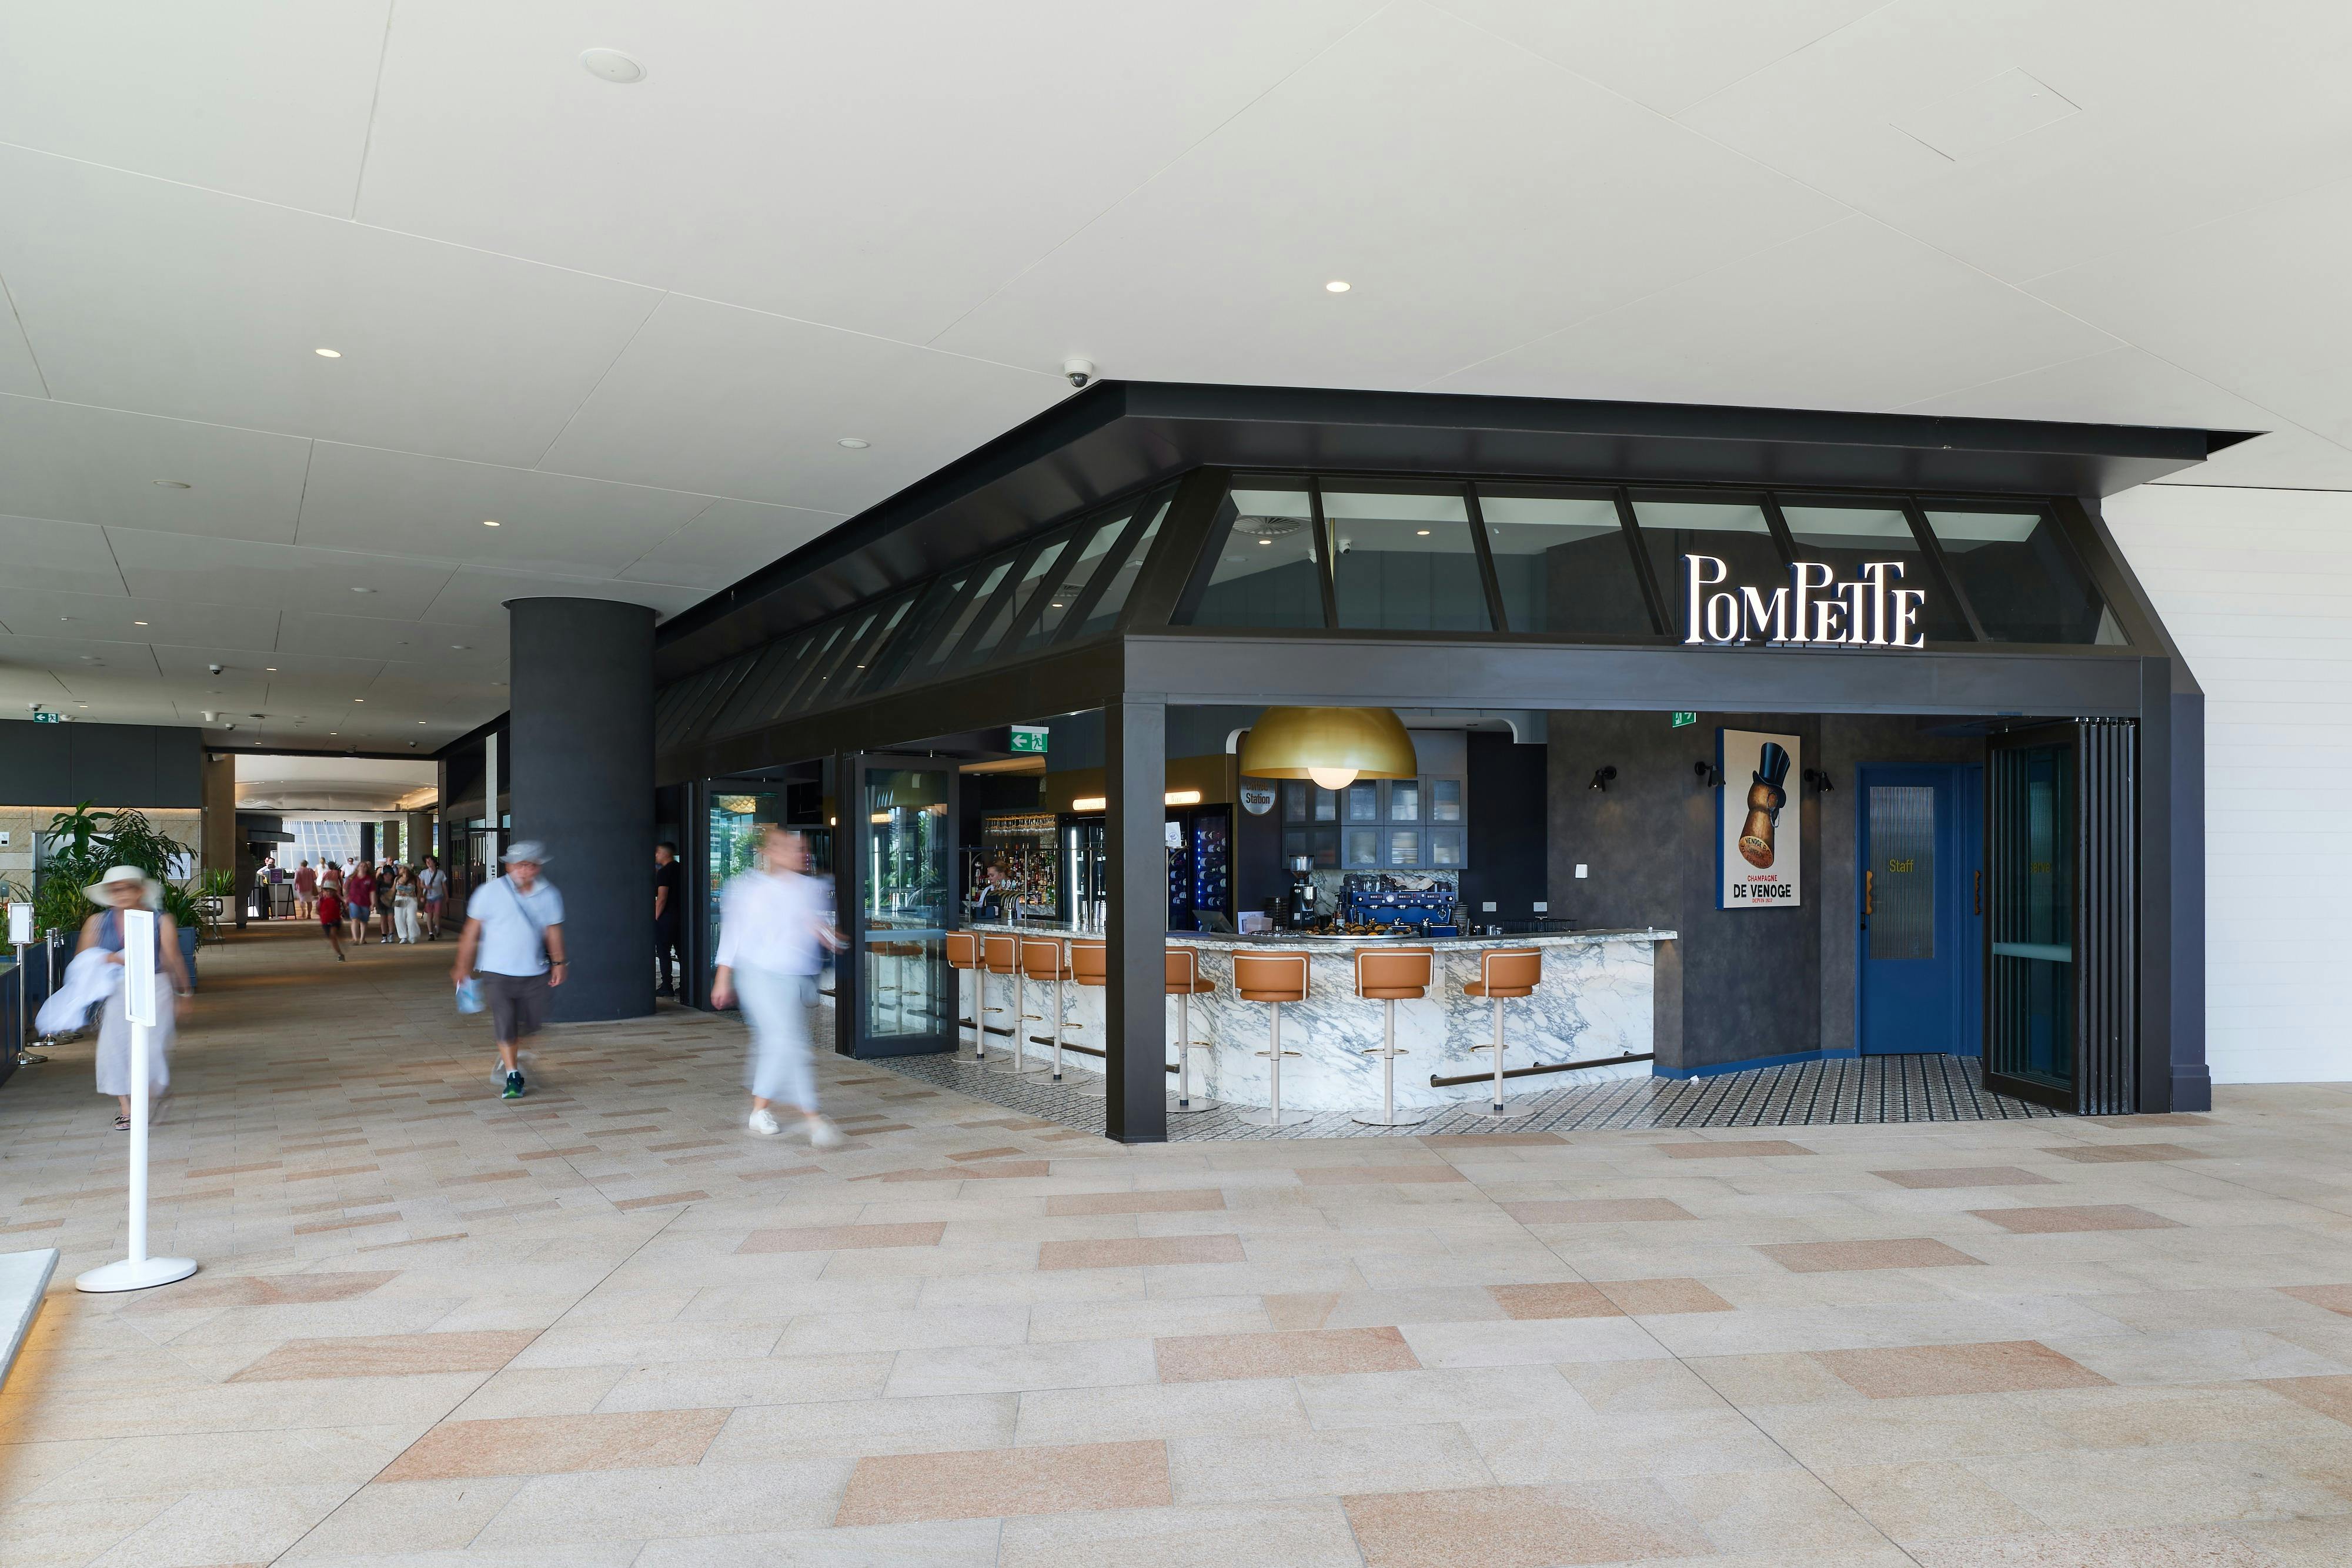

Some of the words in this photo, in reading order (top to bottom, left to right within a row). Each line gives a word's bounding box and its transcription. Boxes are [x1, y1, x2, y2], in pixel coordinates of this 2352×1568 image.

[1681, 554, 1925, 648] POMPETTE
[1246, 793, 1270, 804] Station
[1745, 837, 1763, 848] VENOGE
[1889, 859, 1913, 872] Staff
[1733, 884, 1747, 898] DE
[1750, 884, 1792, 898] VENOGE
